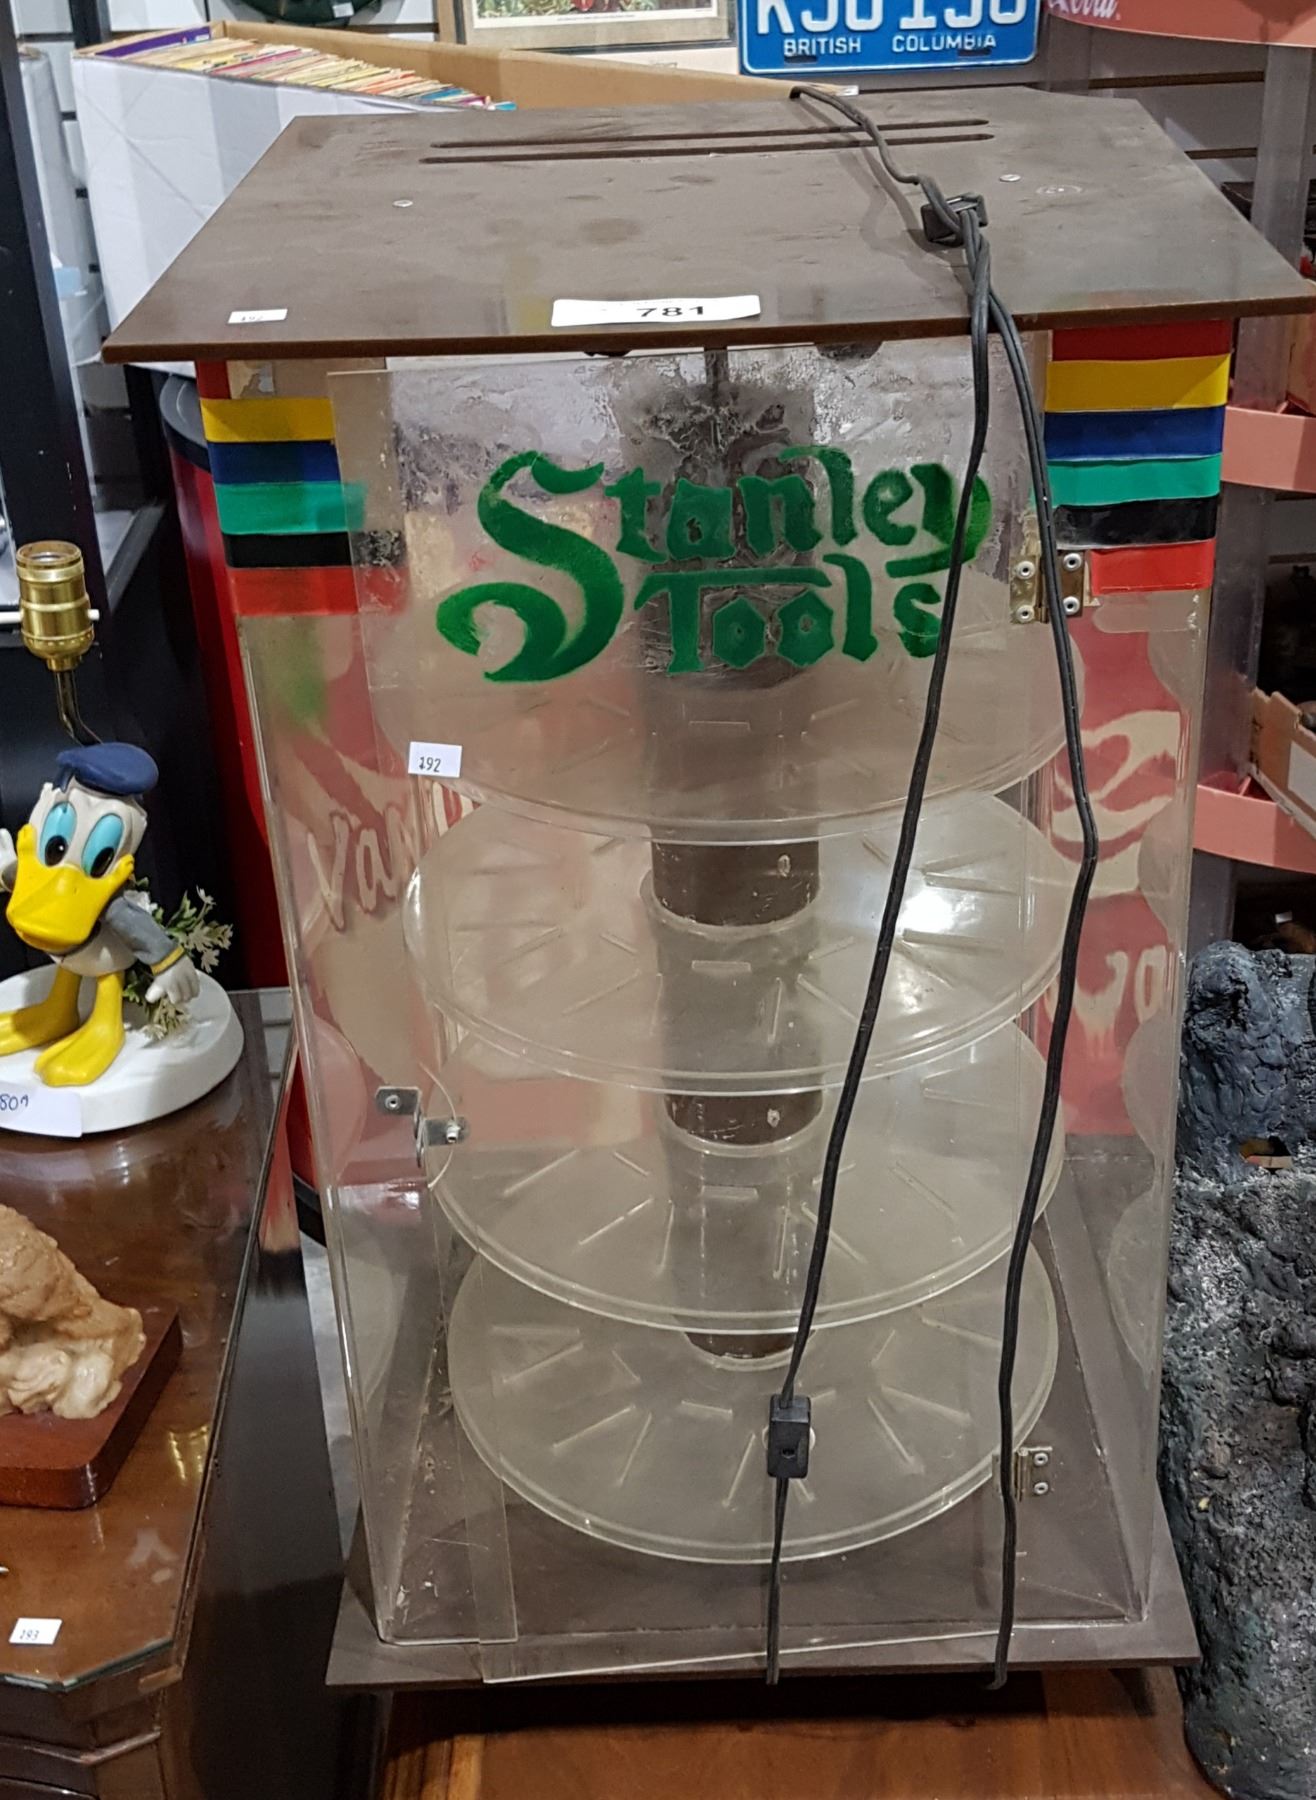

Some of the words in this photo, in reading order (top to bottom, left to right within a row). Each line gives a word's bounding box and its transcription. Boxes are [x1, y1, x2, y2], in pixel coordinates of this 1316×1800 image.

[783, 36, 862, 57] BRITISH
[892, 33, 997, 52] COLUMBIA
[636, 306, 703, 317] 781
[437, 450, 991, 683] Stanley
[634, 553, 944, 674] Tools
